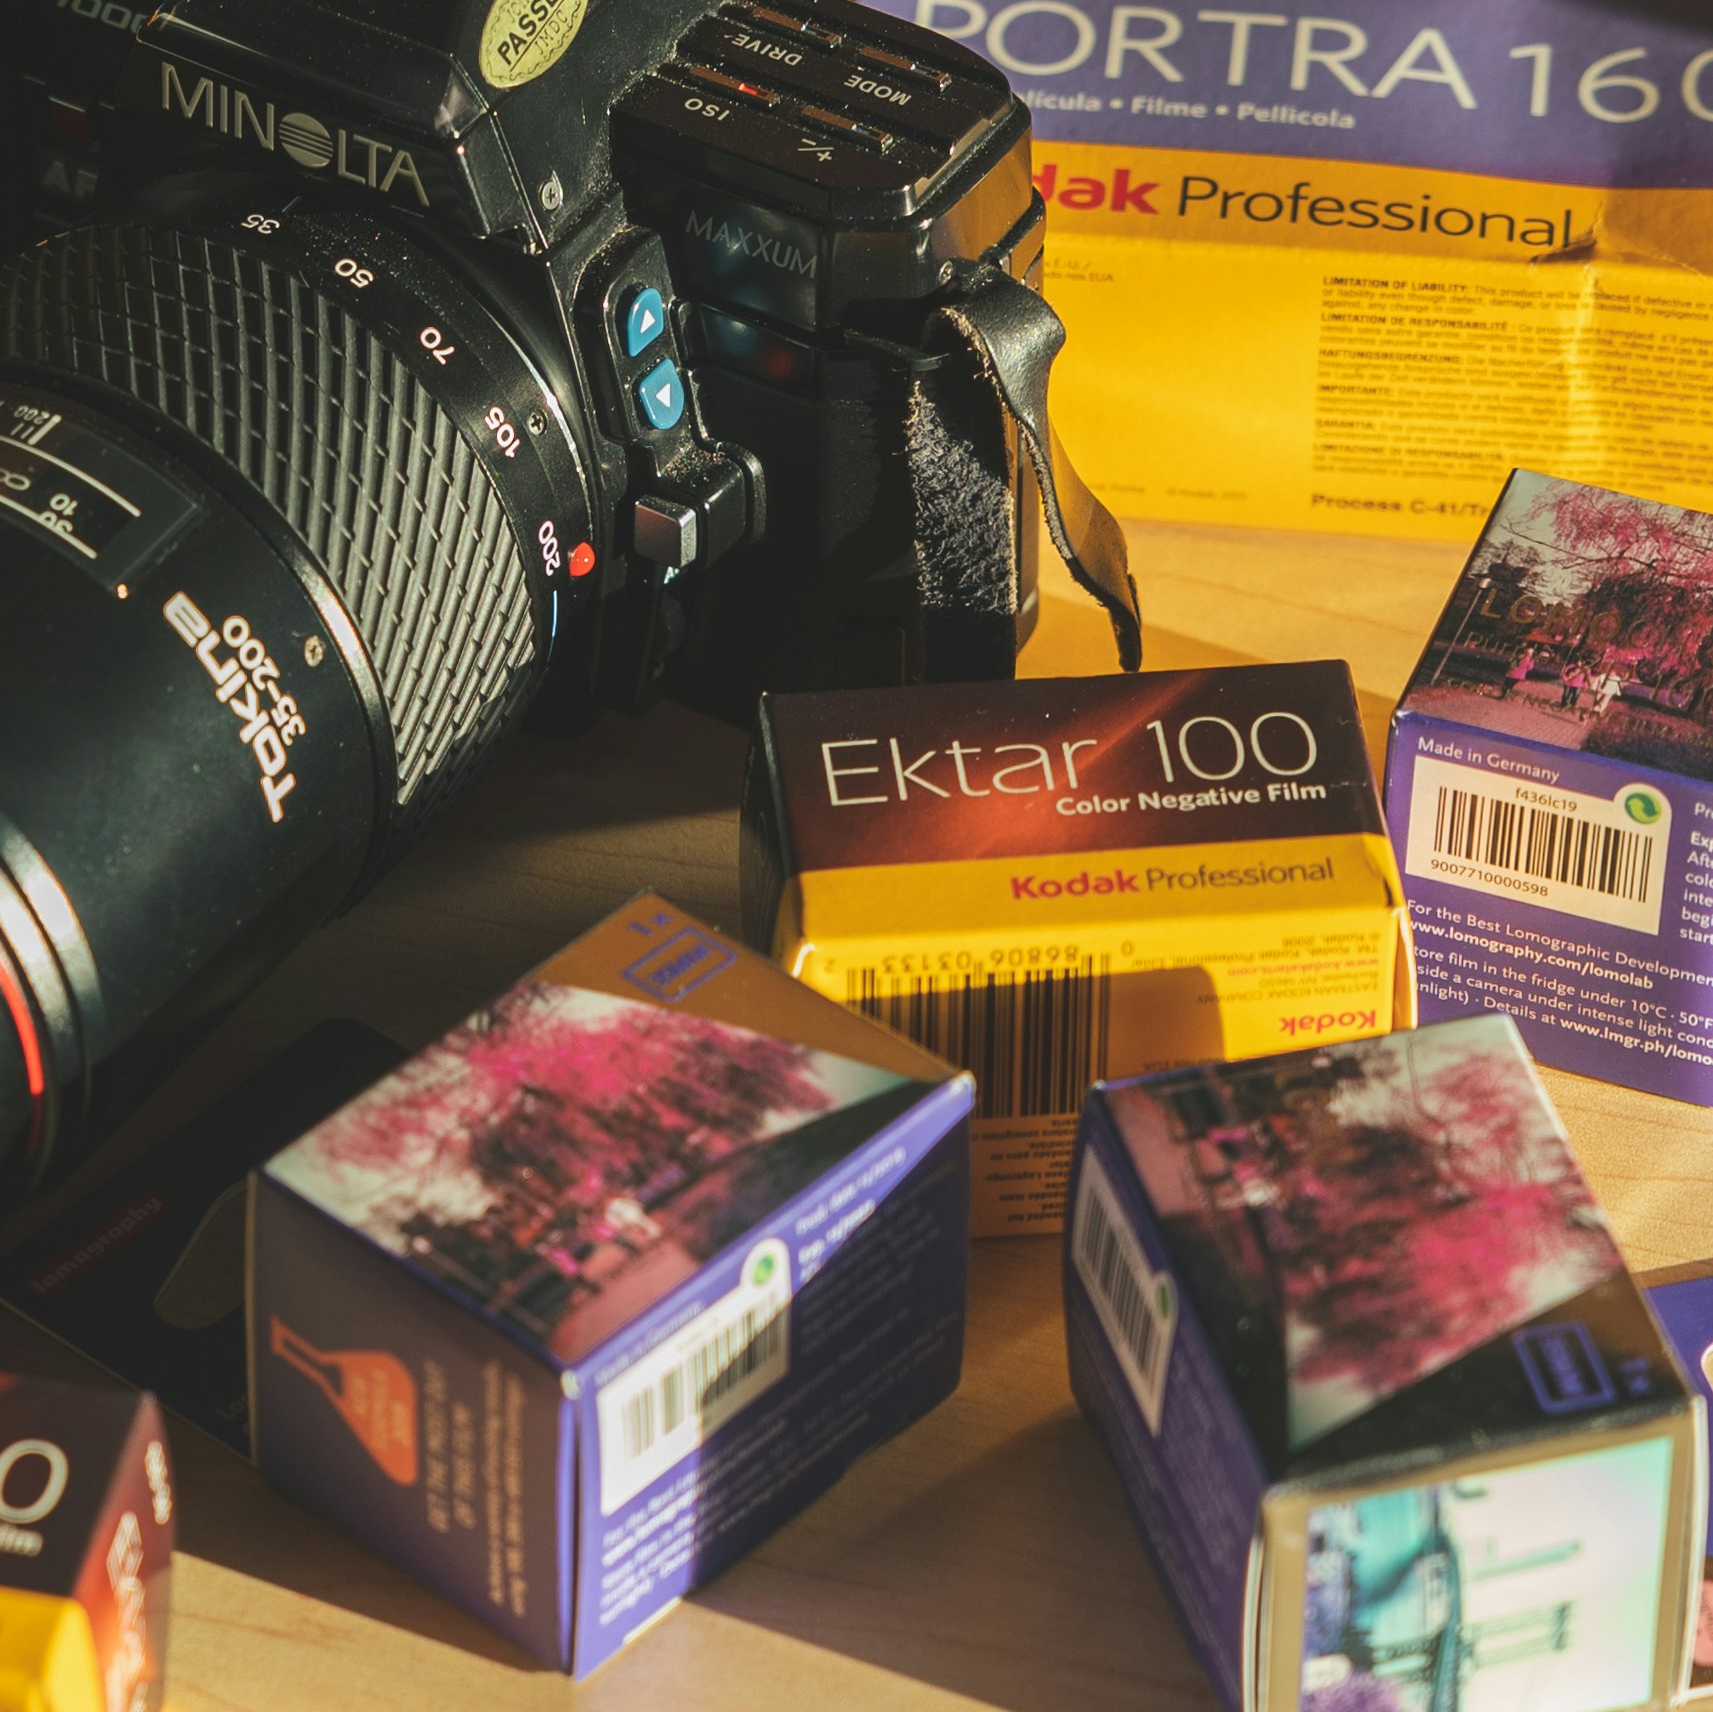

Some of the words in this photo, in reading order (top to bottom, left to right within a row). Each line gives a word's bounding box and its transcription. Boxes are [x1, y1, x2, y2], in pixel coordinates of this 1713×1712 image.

[731, 33, 803, 67] DRIVE
[843, 73, 912, 107] MODE
[683, 97, 730, 122] ISO
[1024, 90, 1102, 113] lícula
[1131, 94, 1207, 120] Filme
[1237, 101, 1356, 130] Pellicola
[161, 61, 431, 208] MINOLTA
[240, 212, 281, 236] 35
[1032, 164, 1161, 217] dak
[1177, 174, 1575, 250] Professional
[687, 209, 819, 280] MAXXUM
[333, 256, 375, 290] 50
[1323, 277, 1388, 288] LIMITATION
[1393, 281, 1407, 290] OF
[1412, 282, 1468, 293] LIABILITY:
[418, 325, 456, 366] 70
[485, 405, 522, 460] 105
[48, 492, 79, 516] 10
[1312, 493, 1402, 514] Process
[536, 518, 562, 577] 200
[222, 614, 305, 745] 35-200
[820, 737, 1097, 808] Ektar
[1146, 711, 1319, 785] 100
[1418, 736, 1464, 760] Made
[1468, 747, 1484, 764] in
[1486, 752, 1561, 785] Germany
[1055, 794, 1131, 817] Color
[1139, 786, 1262, 814] Negative
[1267, 780, 1328, 803] Film
[1010, 867, 1141, 903] Kodak
[1145, 857, 1335, 893] Professional
[1430, 858, 1549, 898] 9007710000598
[881, 952, 971, 974] 03133
[989, 944, 1079, 966] 86806
[1407, 898, 1432, 916] For
[1436, 906, 1462, 924] the
[1467, 913, 1501, 934] Best
[1505, 923, 1611, 962] Lomographic
[1614, 951, 1713, 988] Developmen
[1409, 919, 1654, 991] www.lomography.com/lomolab
[1448, 952, 1478, 971] film
[1482, 961, 1497, 976] in
[1502, 966, 1527, 984] the
[1531, 973, 1576, 997] fridge
[1579, 987, 1626, 1009] under
[1631, 999, 1668, 1020] 10°C
[1452, 973, 1462, 984] a
[1466, 977, 1524, 1000] camera
[1527, 991, 1574, 1012] under
[1577, 1003, 1635, 1030] intense
[1638, 1018, 1674, 1038] light
[1278, 1009, 1379, 1039] Kodak
[1484, 996, 1537, 1021] Details
[1541, 1011, 1557, 1026] at
[29, 1195, 164, 1295] lomography
